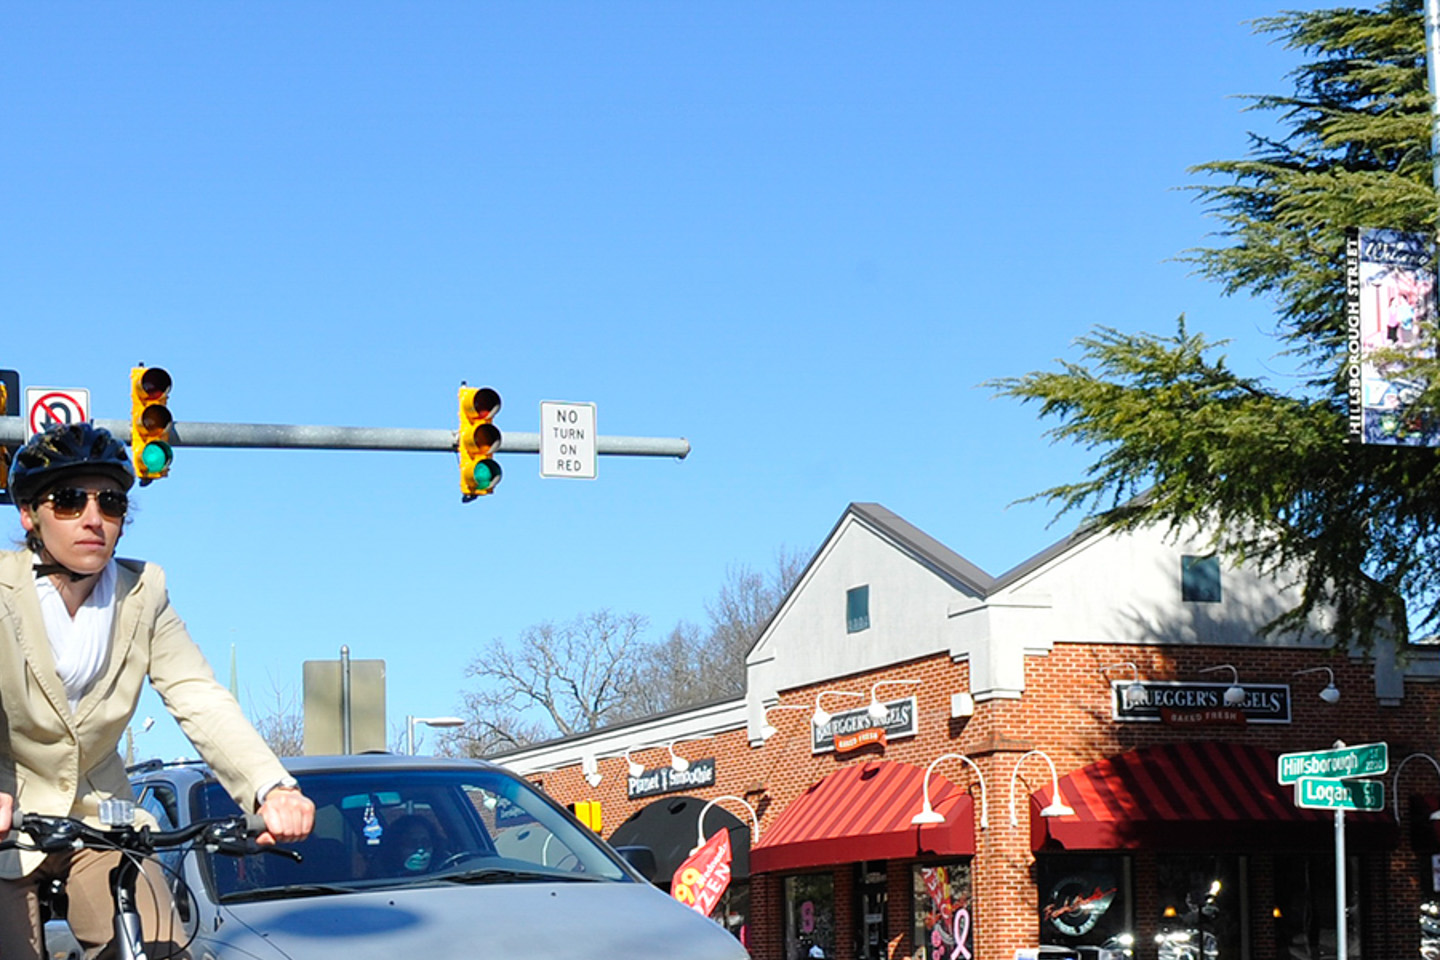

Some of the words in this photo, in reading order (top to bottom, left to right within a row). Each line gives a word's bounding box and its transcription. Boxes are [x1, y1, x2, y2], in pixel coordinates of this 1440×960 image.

[1345, 238, 1359, 296] STREET
[1347, 301, 1361, 435] HILLSBOROUGH
[556, 409, 578, 424] NO
[553, 427, 585, 440] TURN
[559, 443, 577, 456] ON
[556, 459, 582, 472] RED
[1204, 711, 1238, 721] FRESH
[1283, 751, 1359, 776] Hillsborough
[628, 774, 660, 796] Planet
[669, 764, 713, 786] Smoothie
[1306, 781, 1353, 806] Logan
[692, 862, 731, 915] OZEN
